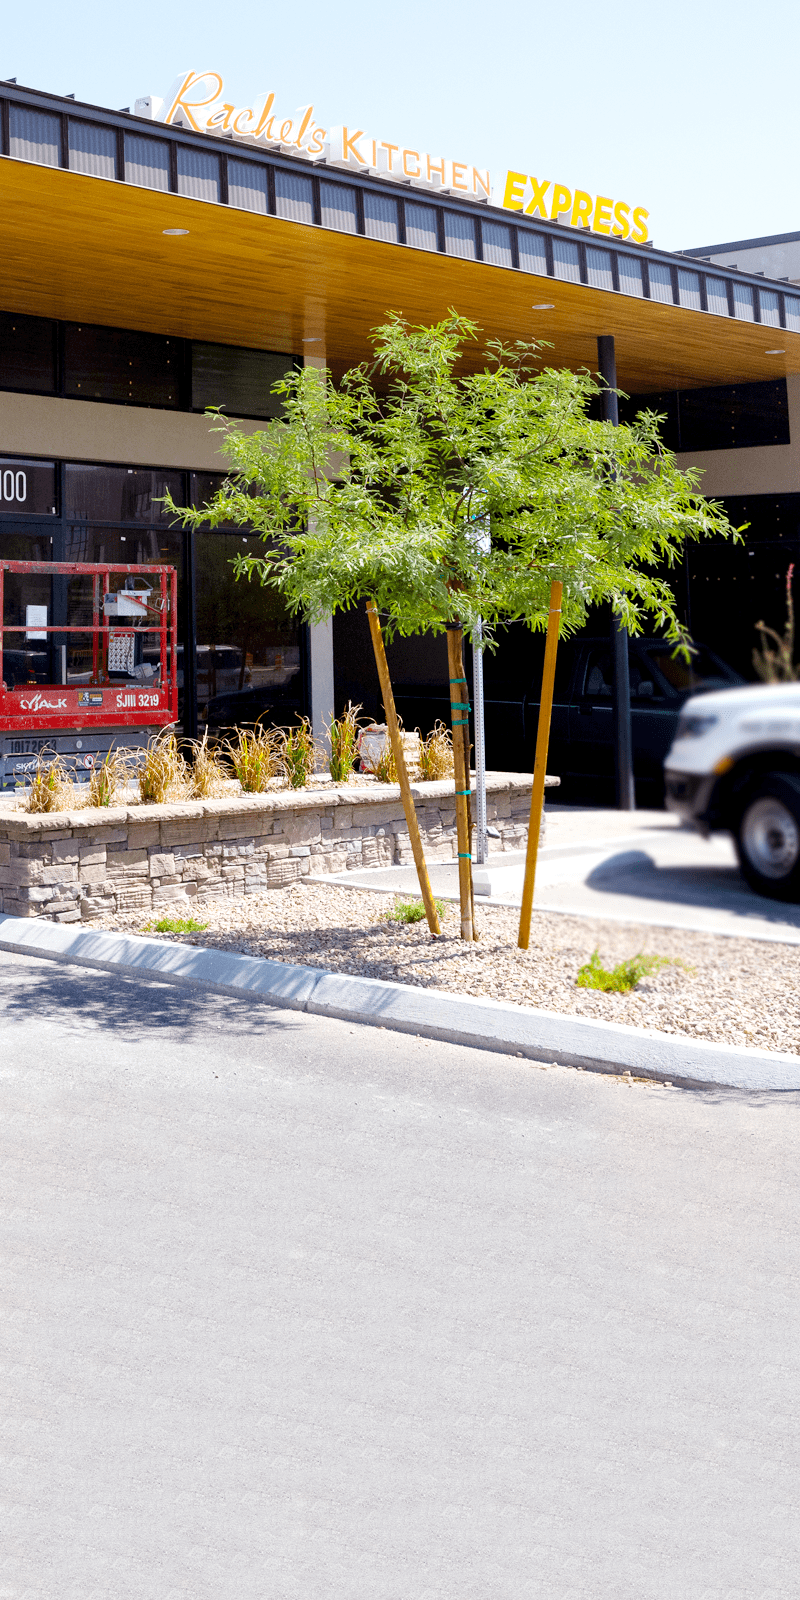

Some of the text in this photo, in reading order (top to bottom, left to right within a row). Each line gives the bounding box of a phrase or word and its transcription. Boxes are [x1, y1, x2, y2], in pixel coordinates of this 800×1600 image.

[165, 71, 650, 244] Rachel's KITCHEN EXPRESS
[138, 694, 159, 707] 3219
